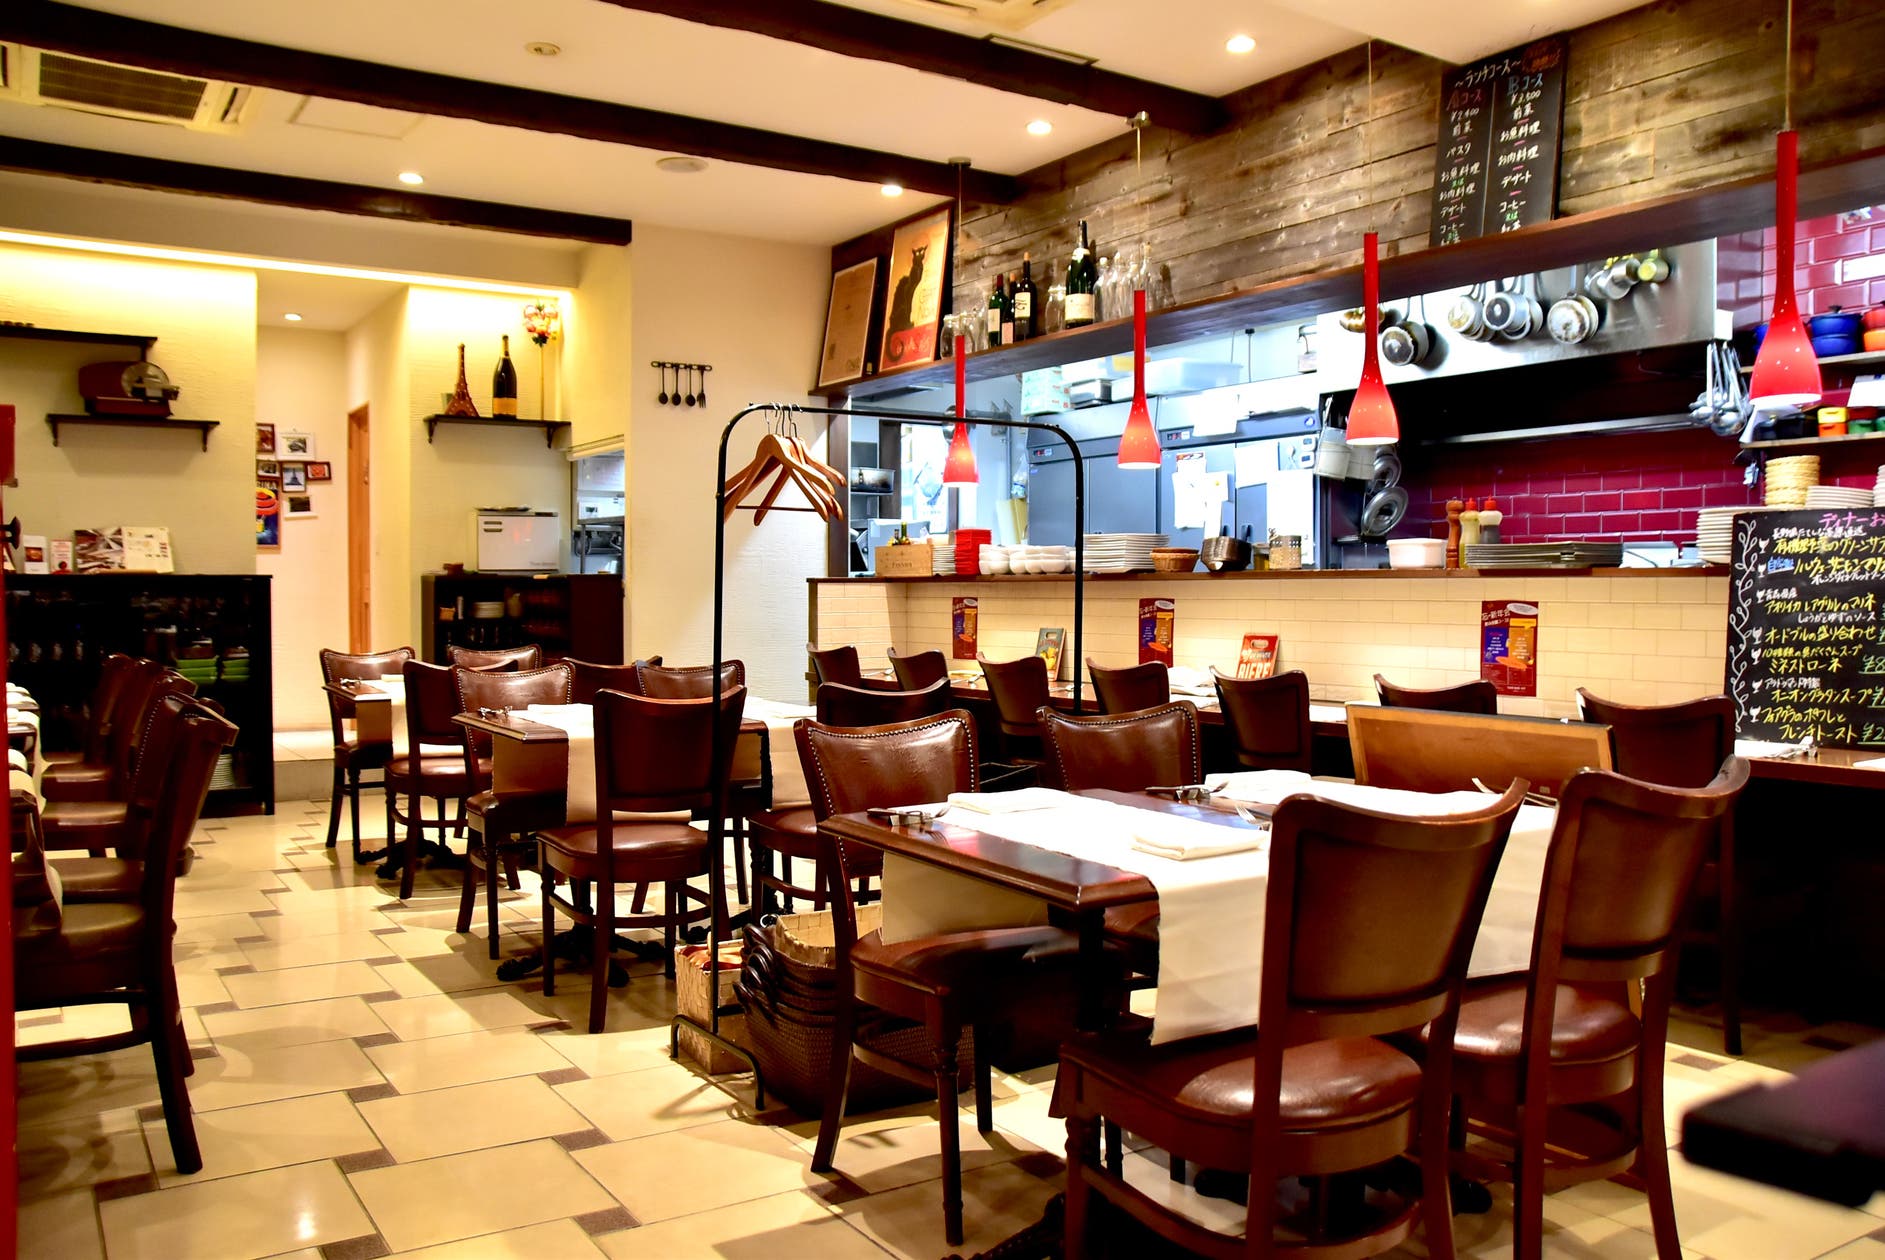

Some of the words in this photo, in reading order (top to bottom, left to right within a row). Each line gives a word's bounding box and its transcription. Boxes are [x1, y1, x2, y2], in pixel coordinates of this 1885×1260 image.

[1499, 120, 1541, 142] お魚料理
[1446, 142, 1472, 158] パスタ
[1498, 144, 1540, 167] お肉料理
[1440, 161, 1481, 183] お魚料理
[1501, 170, 1532, 189] デザート
[1439, 182, 1476, 202] お肉料理
[1440, 202, 1466, 218] デザート
[1499, 199, 1526, 213] コーヒー
[1440, 222, 1465, 234] コーヒー
[1764, 625, 1877, 644] オードブルの盛り合わせ
[1769, 657, 1843, 675] ミネストローネ
[1771, 688, 1873, 704] オニオングラタンスープ
[1779, 723, 1858, 744] フレンチトースト
